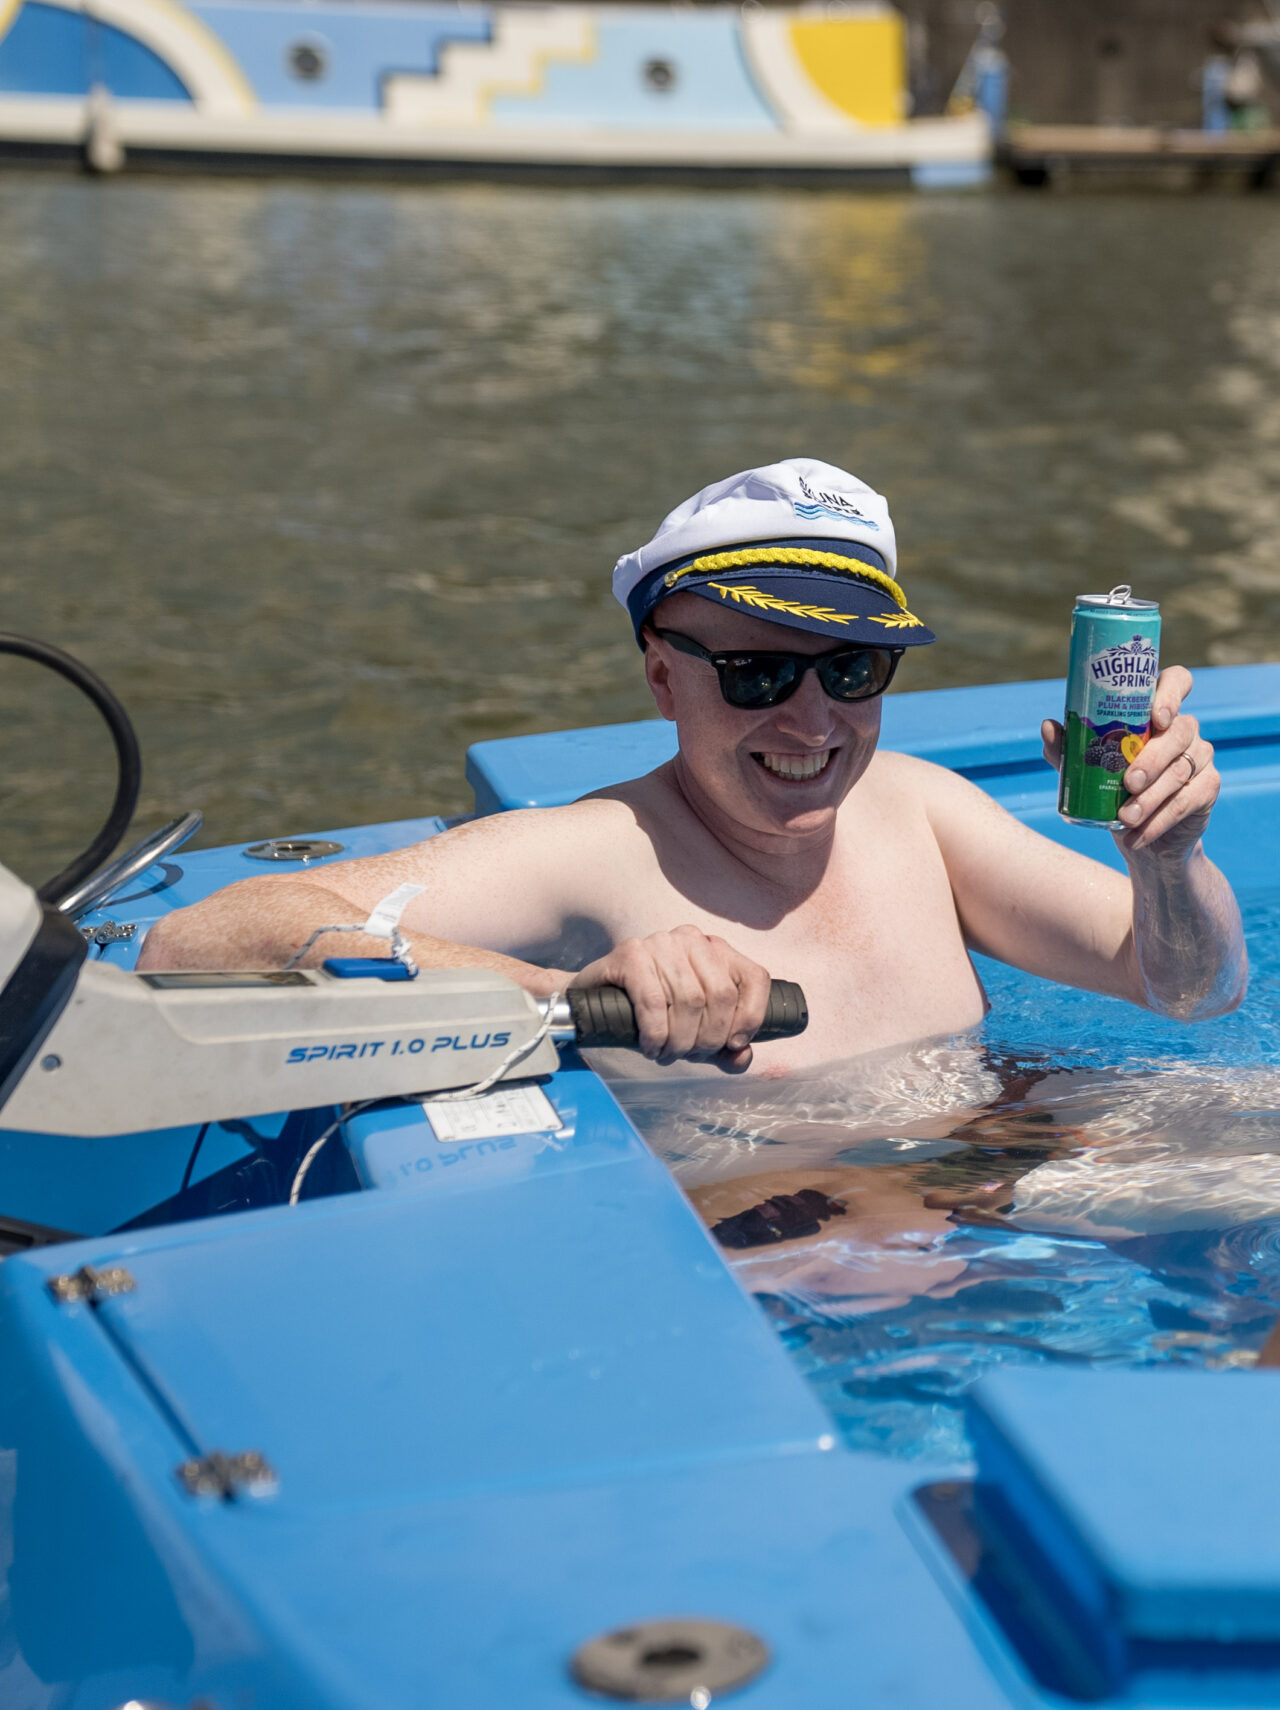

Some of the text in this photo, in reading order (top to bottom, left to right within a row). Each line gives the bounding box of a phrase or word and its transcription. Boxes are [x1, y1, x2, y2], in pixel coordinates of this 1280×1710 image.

[1091, 656, 1158, 680] HIGHLAN
[1111, 674, 1151, 688] SPRING
[1098, 701, 1121, 709] PLUM
[285, 1031, 512, 1064] SPIRIT 1.0 PLUS
